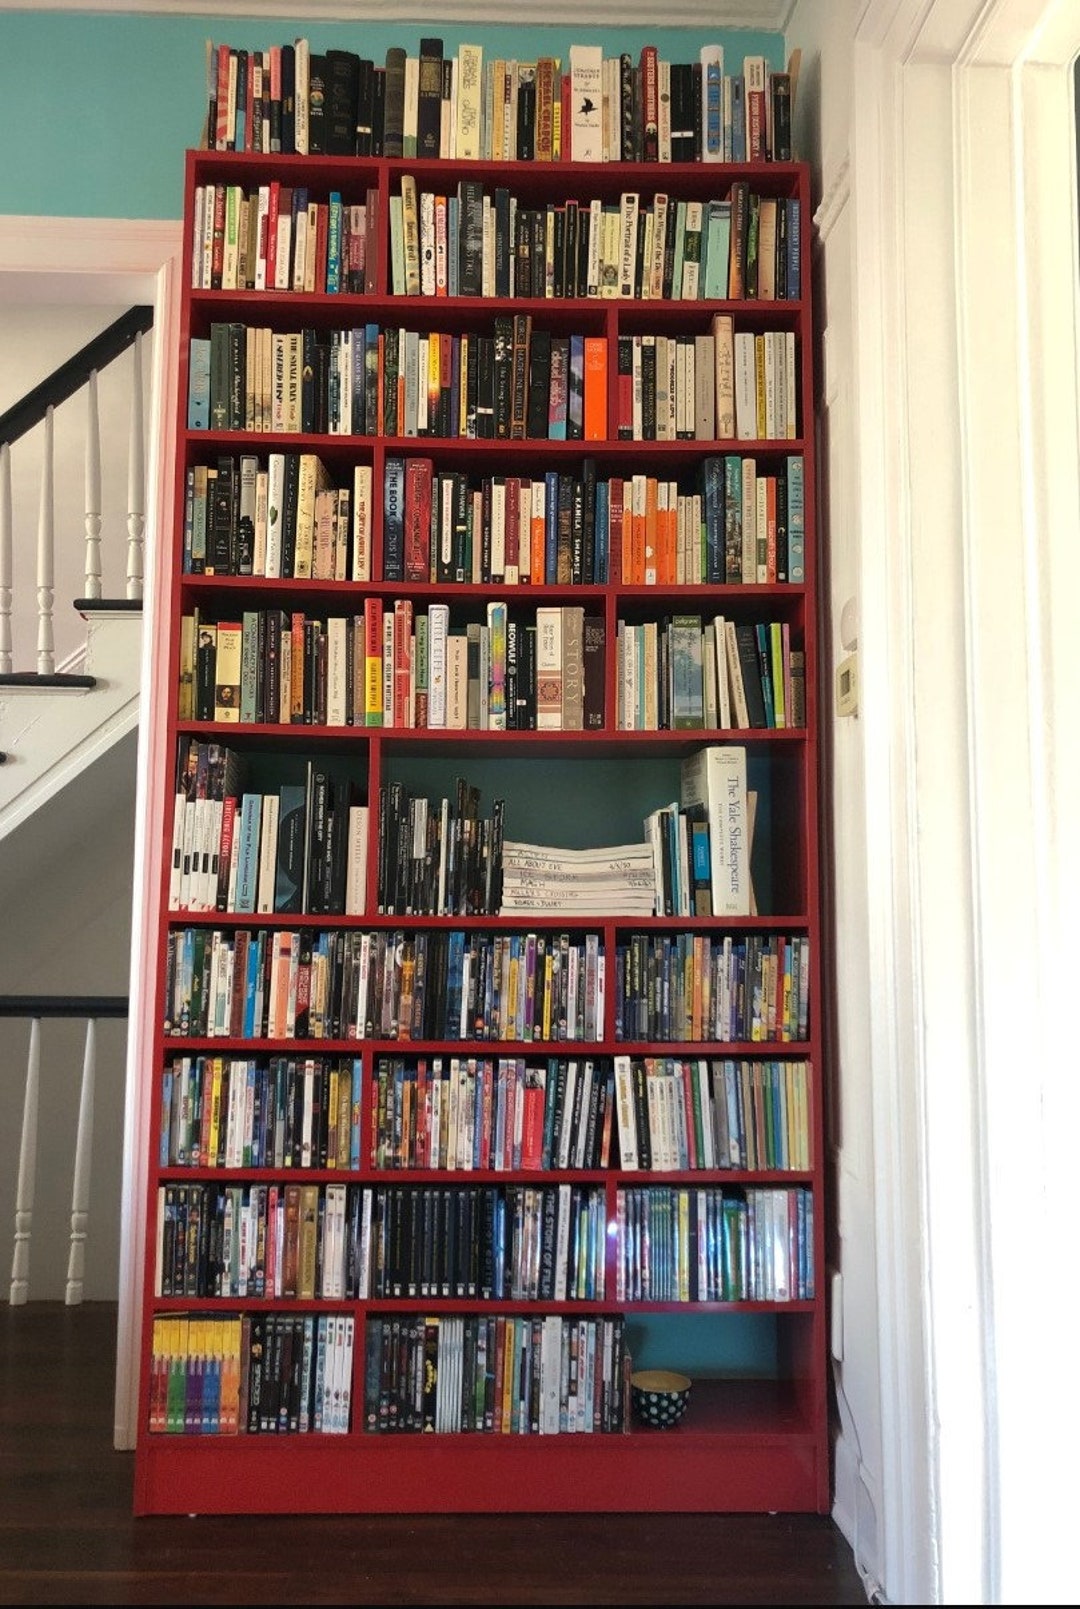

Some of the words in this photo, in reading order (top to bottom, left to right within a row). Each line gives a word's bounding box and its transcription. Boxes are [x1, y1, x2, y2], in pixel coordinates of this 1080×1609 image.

[646, 86, 655, 121] BROTHERS
[626, 206, 635, 220] The
[625, 222, 635, 247] Portrait
[655, 222, 664, 241] Wings
[622, 263, 633, 281] Lady
[517, 319, 527, 344] CIRCE
[289, 336, 298, 354] THE
[289, 355, 298, 382] SMALL
[516, 349, 526, 390] MADELINE
[550, 350, 561, 379] cloud
[230, 375, 241, 415] Mockingbird
[289, 383, 298, 403] RAIN
[515, 391, 525, 420] MILLER
[550, 380, 561, 406] atlas
[389, 471, 398, 488] THE
[458, 483, 466, 494] IAN
[388, 489, 398, 517] BOOK
[458, 495, 466, 519] RANKIN
[389, 535, 397, 558] DUST
[574, 538, 582, 575] SHAMSIE
[434, 613, 443, 645] STILL
[508, 623, 516, 664] BEOWULF
[434, 649, 443, 672] LIFE
[566, 638, 579, 705] STORY
[728, 775, 739, 798] The
[224, 800, 234, 833] DIRECTING
[353, 809, 364, 836] ORSON
[728, 799, 740, 824] Yale
[222, 834, 232, 858] ACTORS
[353, 837, 364, 865] WELLES
[508, 858, 521, 866] ALL
[524, 859, 546, 869] ABOUT
[548, 863, 563, 871] EVE
[726, 826, 741, 894] Shakespeare
[547, 1193, 555, 1214] THE
[545, 1215, 555, 1252] STORY
[541, 1268, 551, 1296] FILM
